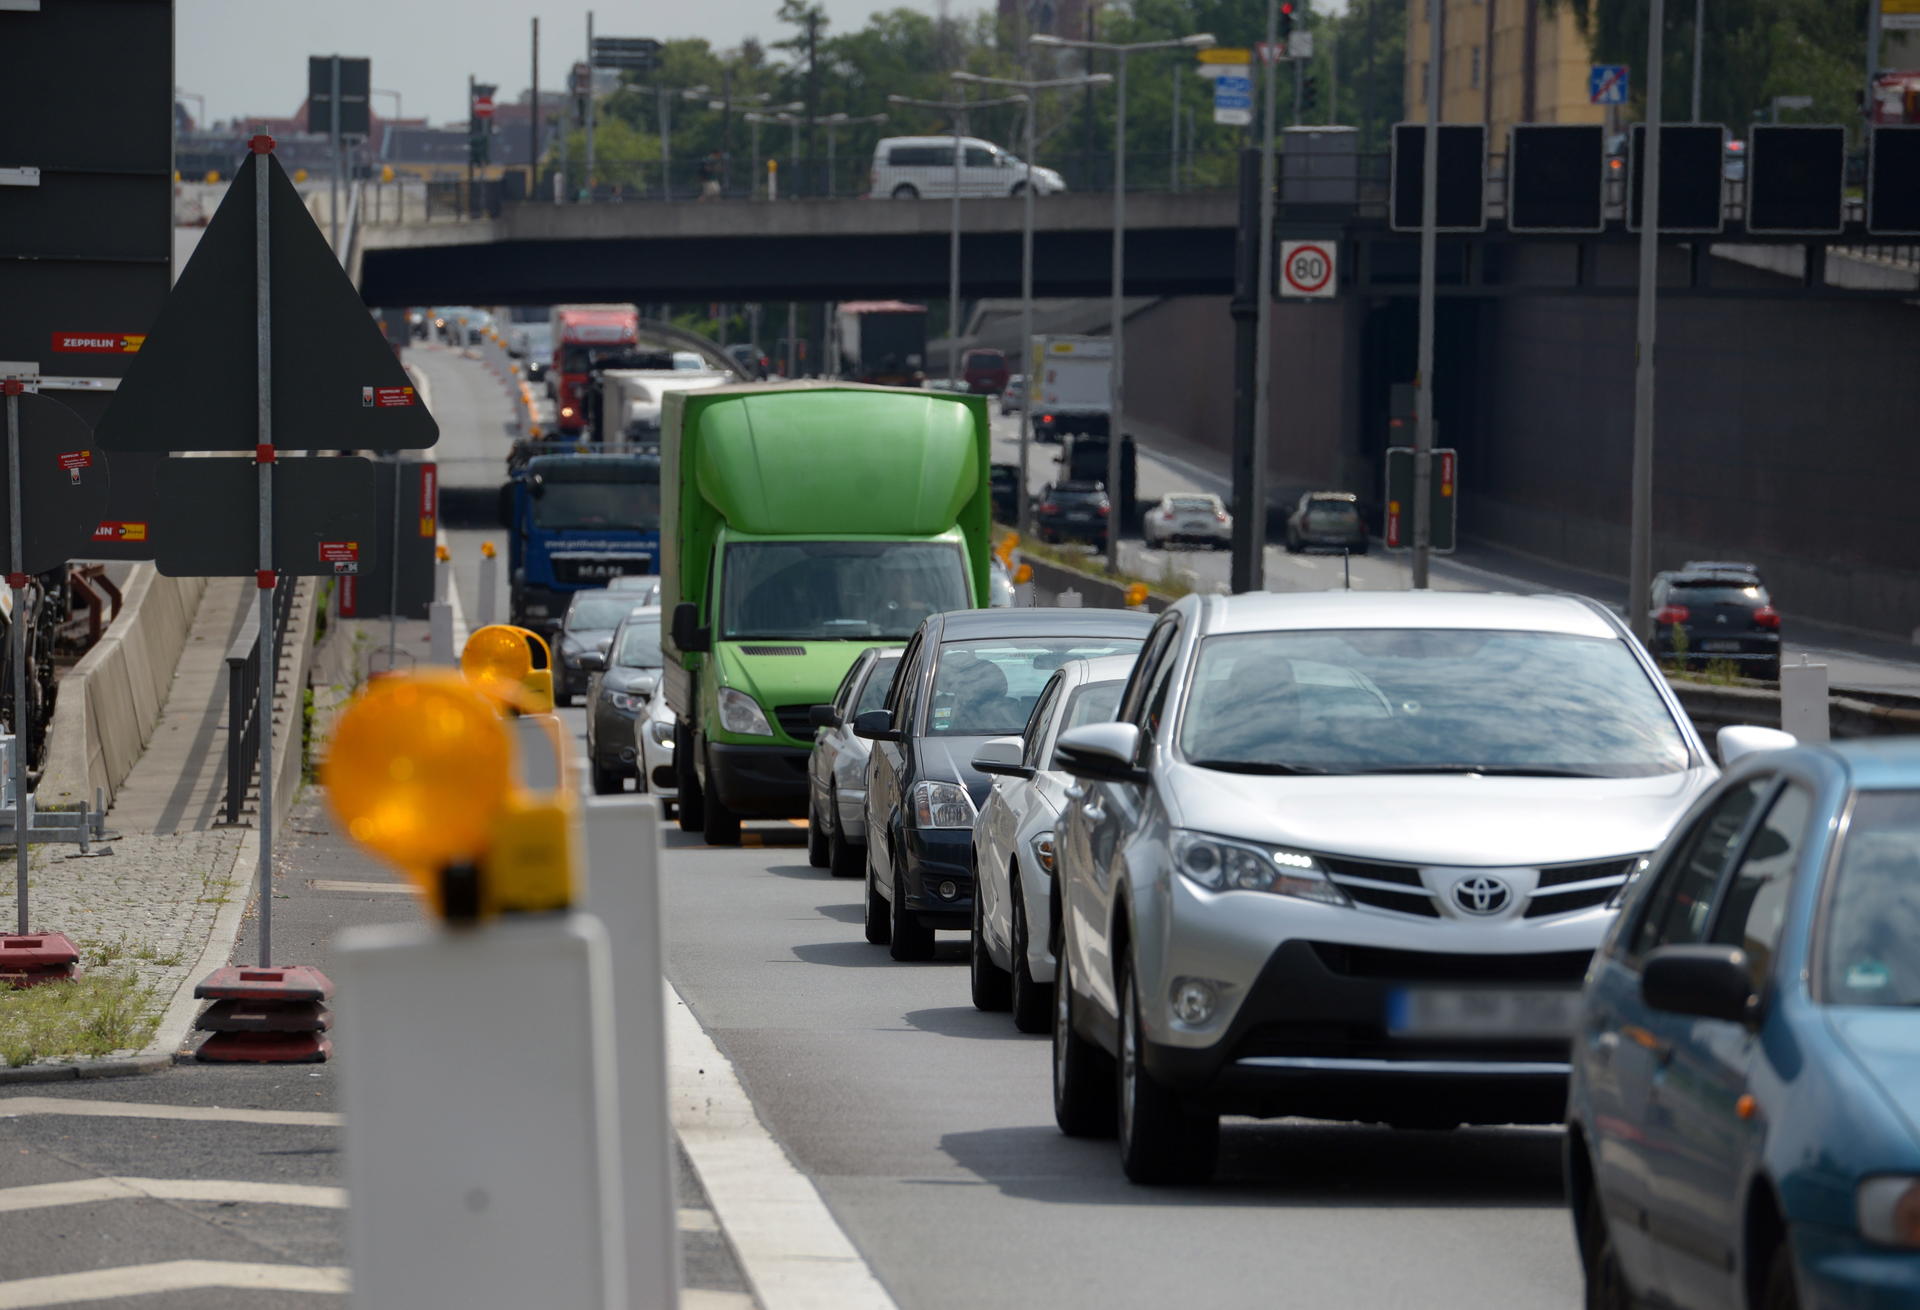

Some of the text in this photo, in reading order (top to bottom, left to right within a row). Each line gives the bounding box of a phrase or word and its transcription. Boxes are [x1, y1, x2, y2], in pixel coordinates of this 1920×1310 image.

[1295, 257, 1322, 280] 80
[63, 338, 114, 348] ZEPPELIN
[578, 566, 624, 576] MAN
